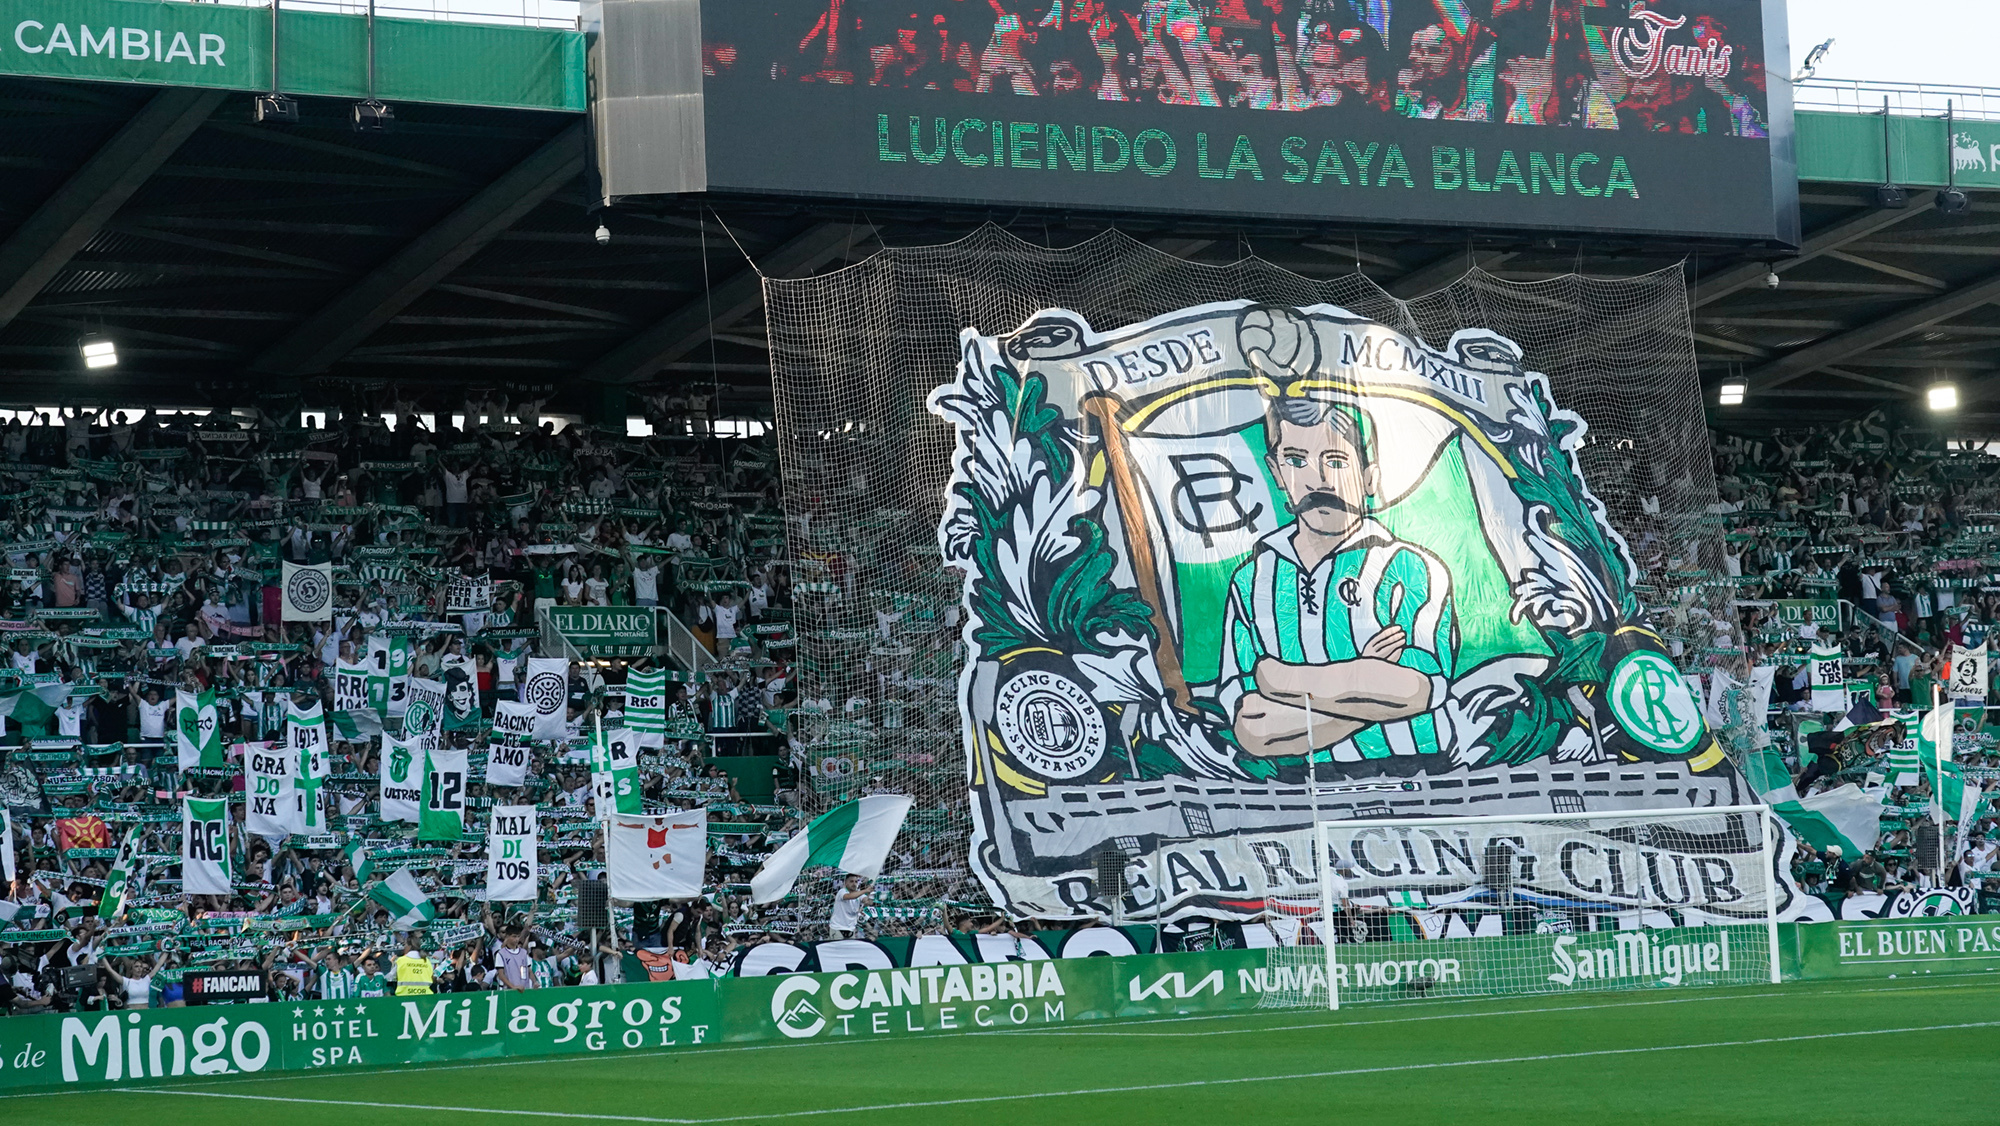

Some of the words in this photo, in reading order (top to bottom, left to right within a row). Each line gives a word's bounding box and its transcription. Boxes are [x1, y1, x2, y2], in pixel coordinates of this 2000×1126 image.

[14, 20, 226, 67] CAMBIAR
[1611, 9, 1731, 79] Tanis
[878, 113, 1177, 178] LUCIENDO
[1197, 132, 1265, 182] LA
[1281, 136, 1415, 188] SAYA
[1431, 145, 1640, 199] BLANCA
[1083, 329, 1222, 392] DESDE
[1341, 334, 1485, 404] MCMXIII
[290, 571, 313, 586] RACING
[313, 571, 327, 587] CLUB
[292, 597, 327, 612] SANTANDER
[555, 613, 580, 631] EL
[582, 613, 650, 632] DIARIO
[613, 630, 649, 638] MONTAÑÉS
[1819, 659, 1841, 674] FCK
[1819, 671, 1842, 685] TBS
[630, 695, 658, 708] RRC
[1000, 674, 1050, 714] RACING
[1055, 677, 1095, 715] CLUB
[495, 710, 535, 733] RACING
[503, 733, 521, 748] TE
[492, 746, 524, 767] AMO
[1009, 733, 1100, 773] SANTANDER
[252, 754, 287, 775] GRA
[255, 775, 280, 796] DO
[385, 787, 421, 802] ULTRAS
[430, 772, 462, 809] 12
[253, 796, 277, 816] NA
[495, 815, 531, 836] MAL
[310, 836, 333, 844] RACING
[502, 838, 523, 859] DI
[496, 860, 530, 881] TOS
[1559, 839, 1746, 903] CLUB
[16, 932, 44, 940] RACING
[1839, 932, 1872, 957] EL
[1877, 929, 1946, 956] BUEN
[1355, 958, 1461, 989] MOTOR
[191, 975, 261, 994] #FANCAM
[830, 962, 1066, 1011] CANTABRIA
[1129, 969, 1224, 1001] KIA
[397, 990, 682, 1044] Milagros
[836, 1000, 1065, 1036] TELECOM
[293, 1020, 379, 1042] HOTEL
[586, 1024, 709, 1051] GOLF
[13, 1042, 46, 1069] de
[61, 1012, 271, 1082] Mingo
[312, 1046, 363, 1067] SPA
